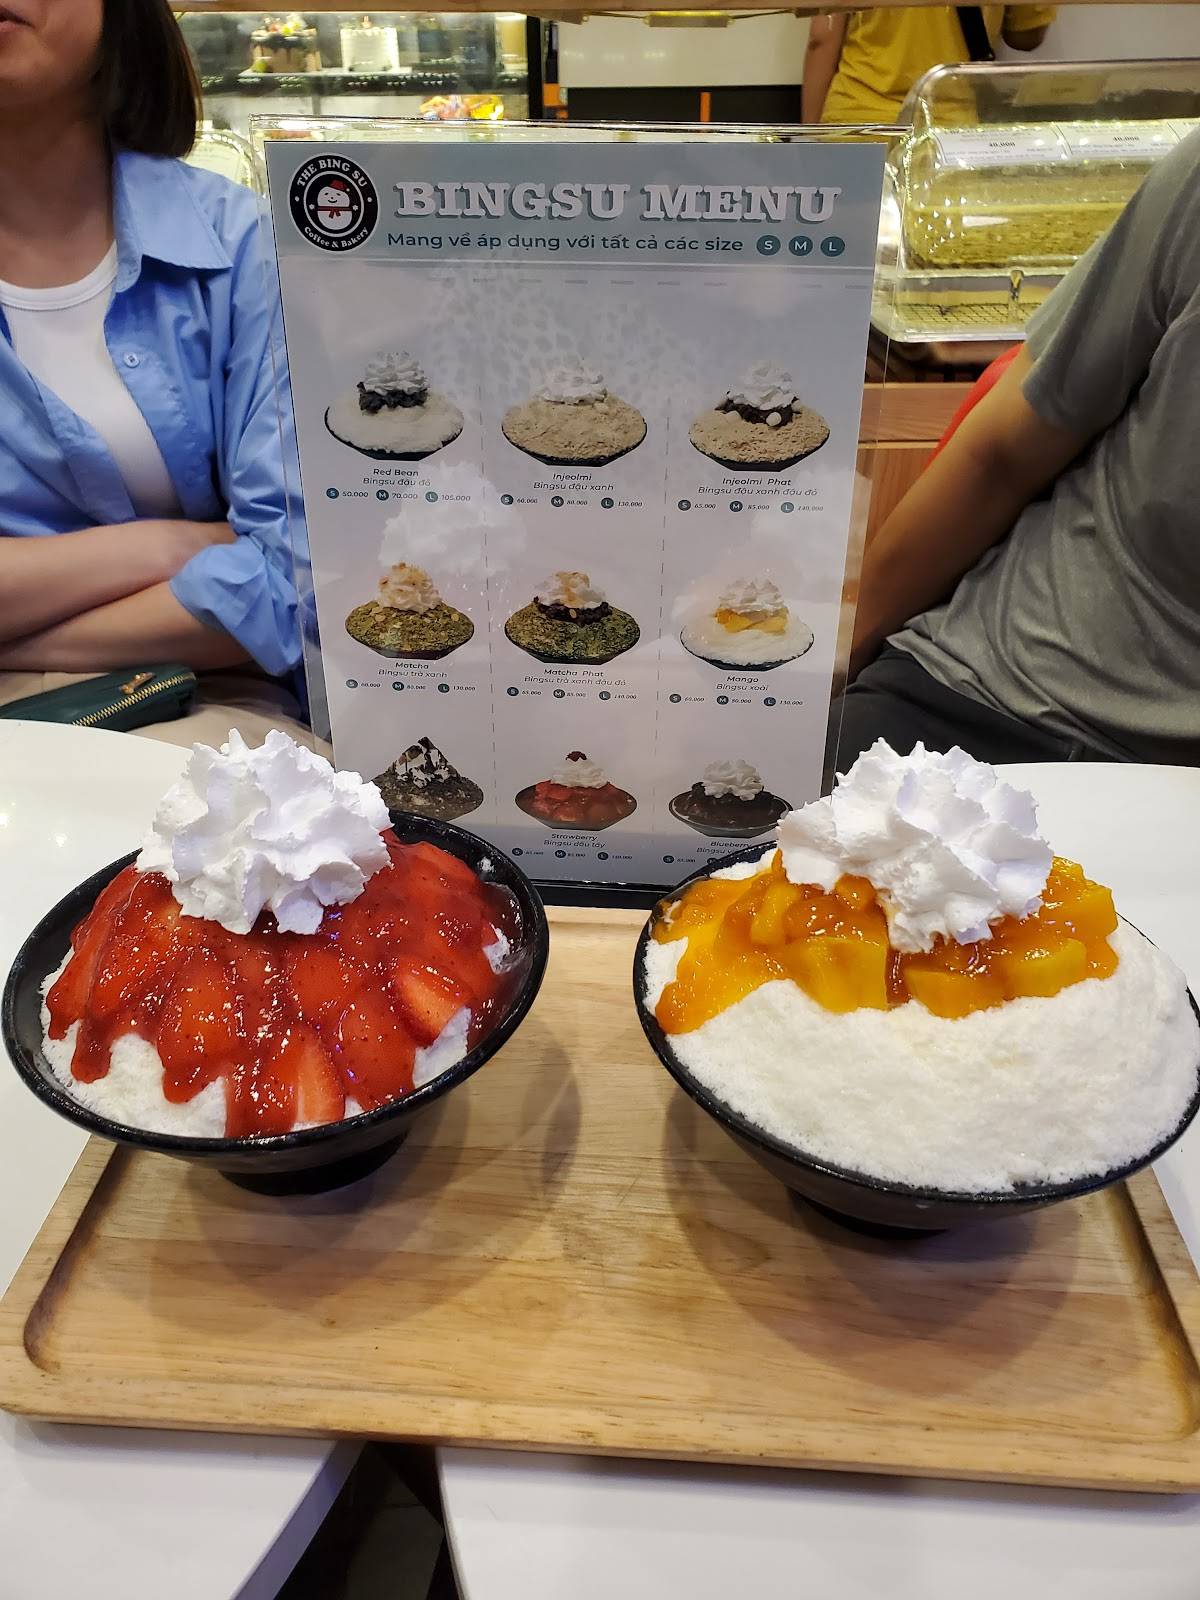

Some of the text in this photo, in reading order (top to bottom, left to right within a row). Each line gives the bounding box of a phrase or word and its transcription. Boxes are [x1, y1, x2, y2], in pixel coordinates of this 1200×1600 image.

[297, 159, 368, 187] THE BING SU
[393, 181, 842, 224] BINGSU MENU
[304, 226, 369, 248] Coffee & Bakery
[388, 233, 443, 249] Mang
[449, 233, 471, 248] về
[477, 234, 501, 250] áp
[507, 234, 560, 251] dụng
[566, 234, 595, 250] với
[601, 234, 630, 250] tất
[635, 233, 659, 250] cả
[664, 236, 699, 251] các
[705, 236, 744, 251] size
[373, 468, 419, 477] Red Bean
[363, 477, 395, 487] Bingsu
[552, 473, 592, 482] Injeolmi
[722, 477, 792, 487] Injeolmi Phat
[533, 482, 567, 491] Bingsu
[698, 487, 732, 496] Bingsu
[378, 669, 409, 677] Bingsu
[544, 669, 578, 677] Matcha
[716, 683, 747, 692] Bingsu
